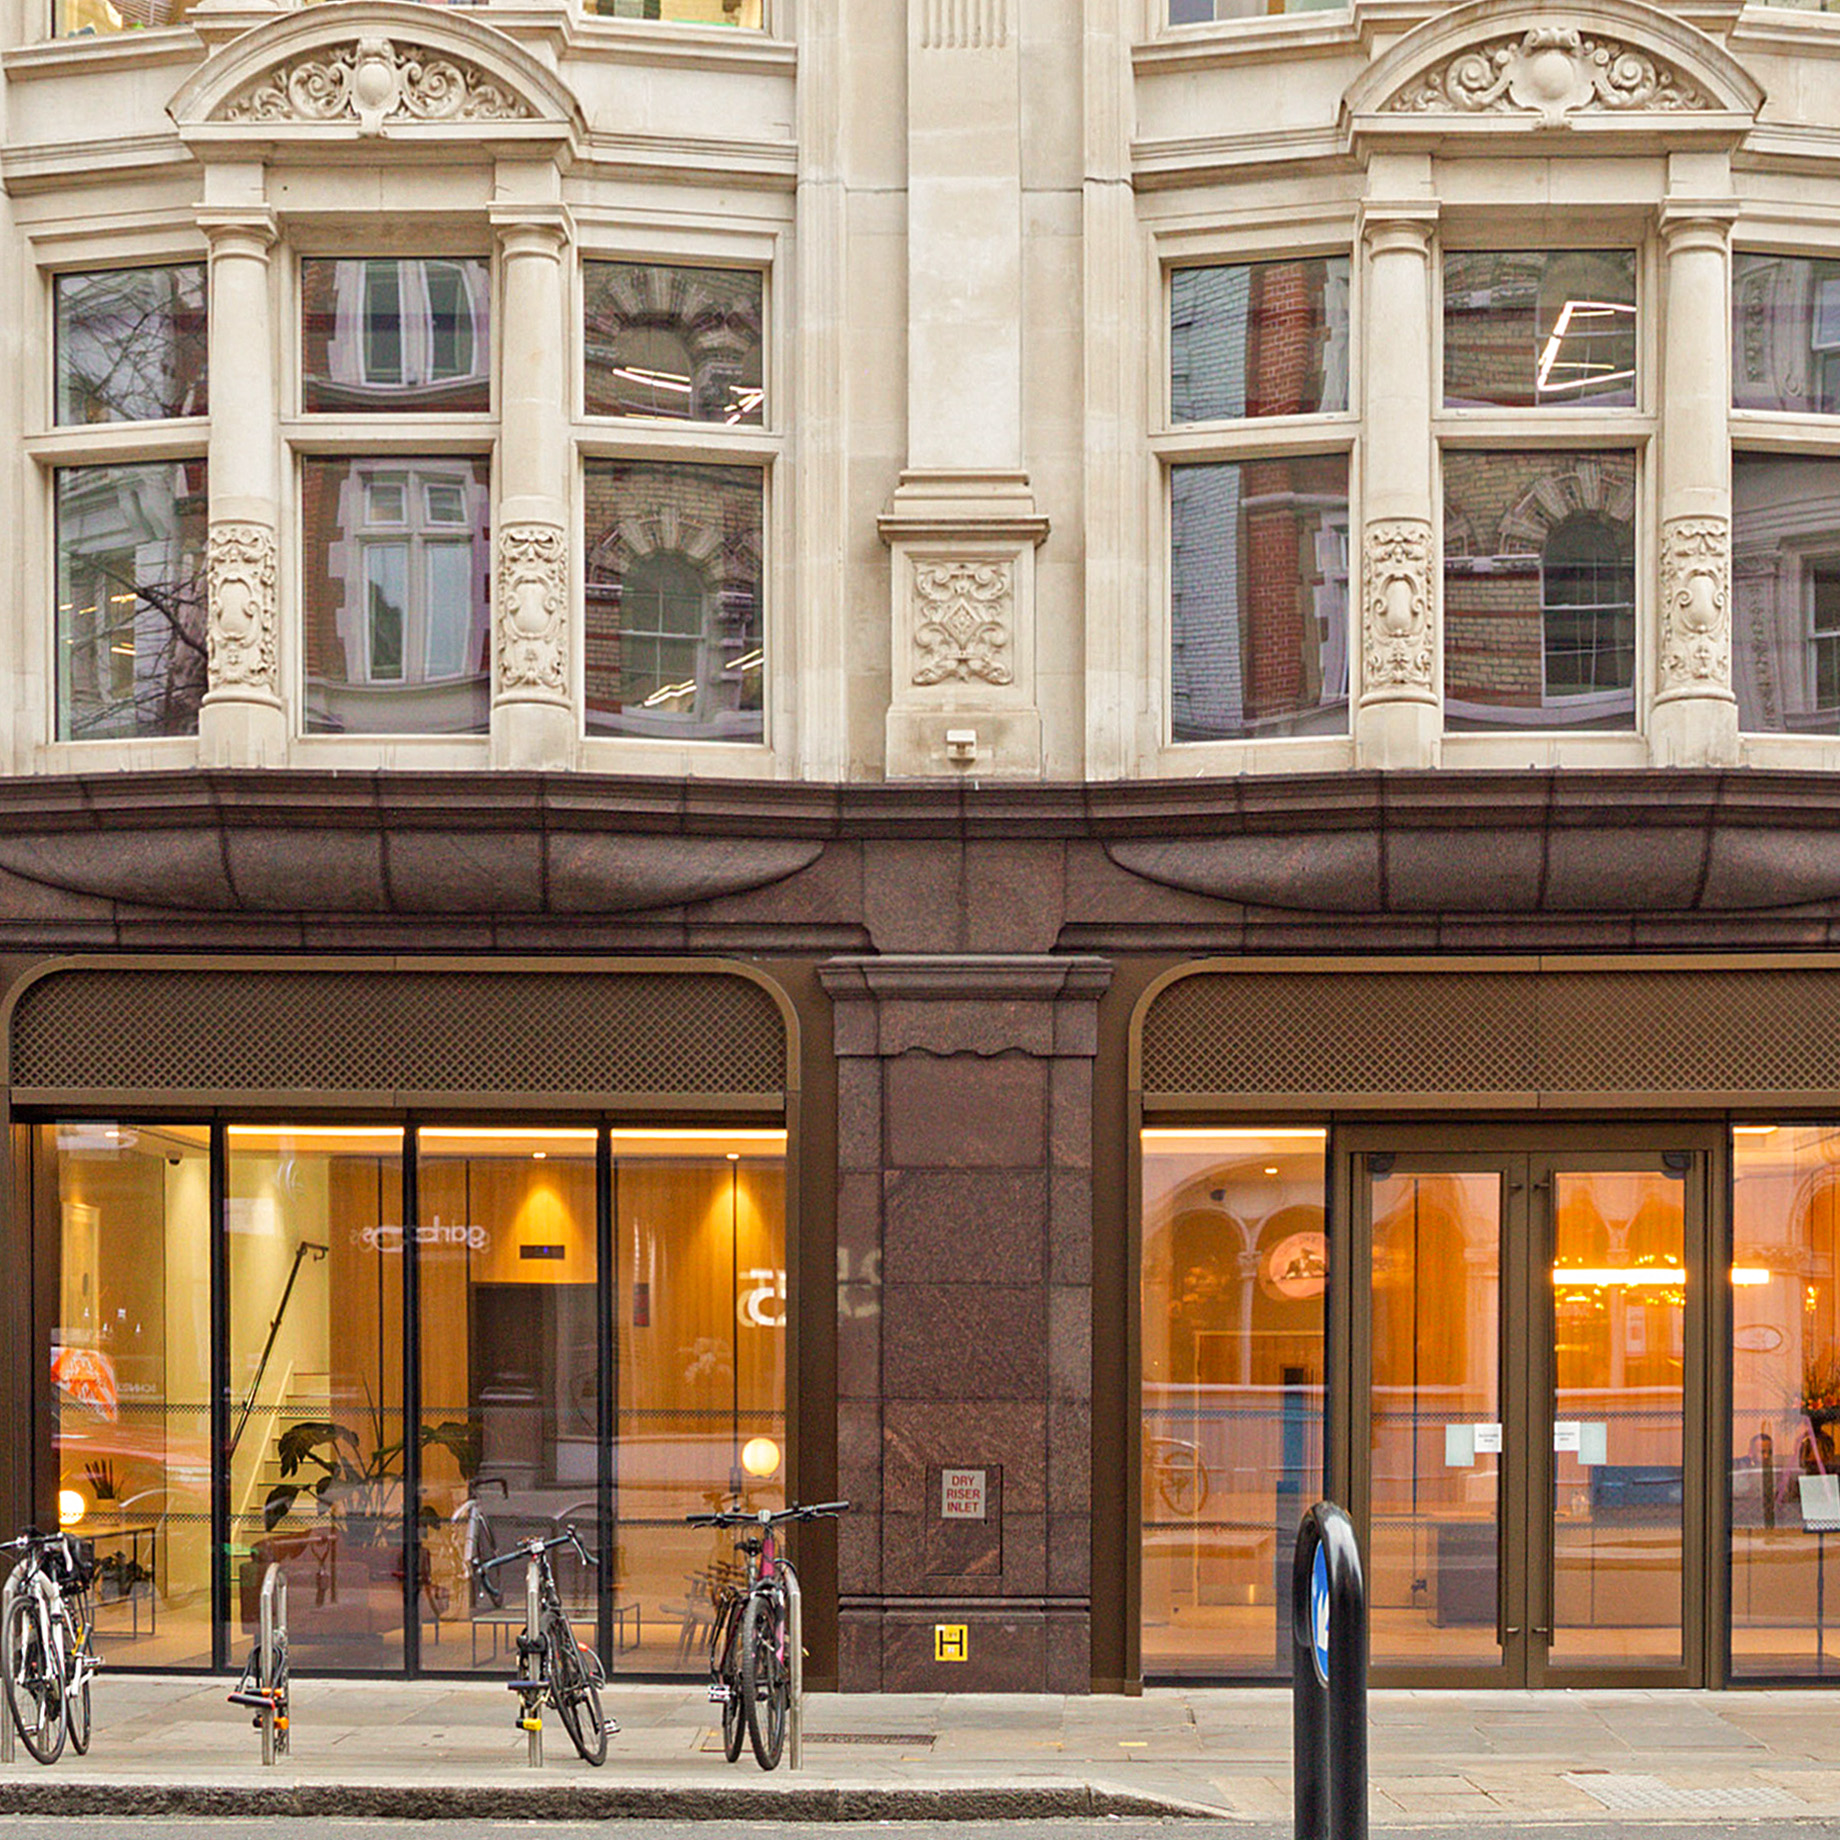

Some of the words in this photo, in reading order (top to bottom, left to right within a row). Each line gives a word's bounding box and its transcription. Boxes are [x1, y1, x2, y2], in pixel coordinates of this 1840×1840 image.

[952, 1475, 975, 1487] DRY
[946, 1488, 981, 1500] RISER
[947, 1501, 979, 1513] INLET
[939, 1629, 963, 1657] H
